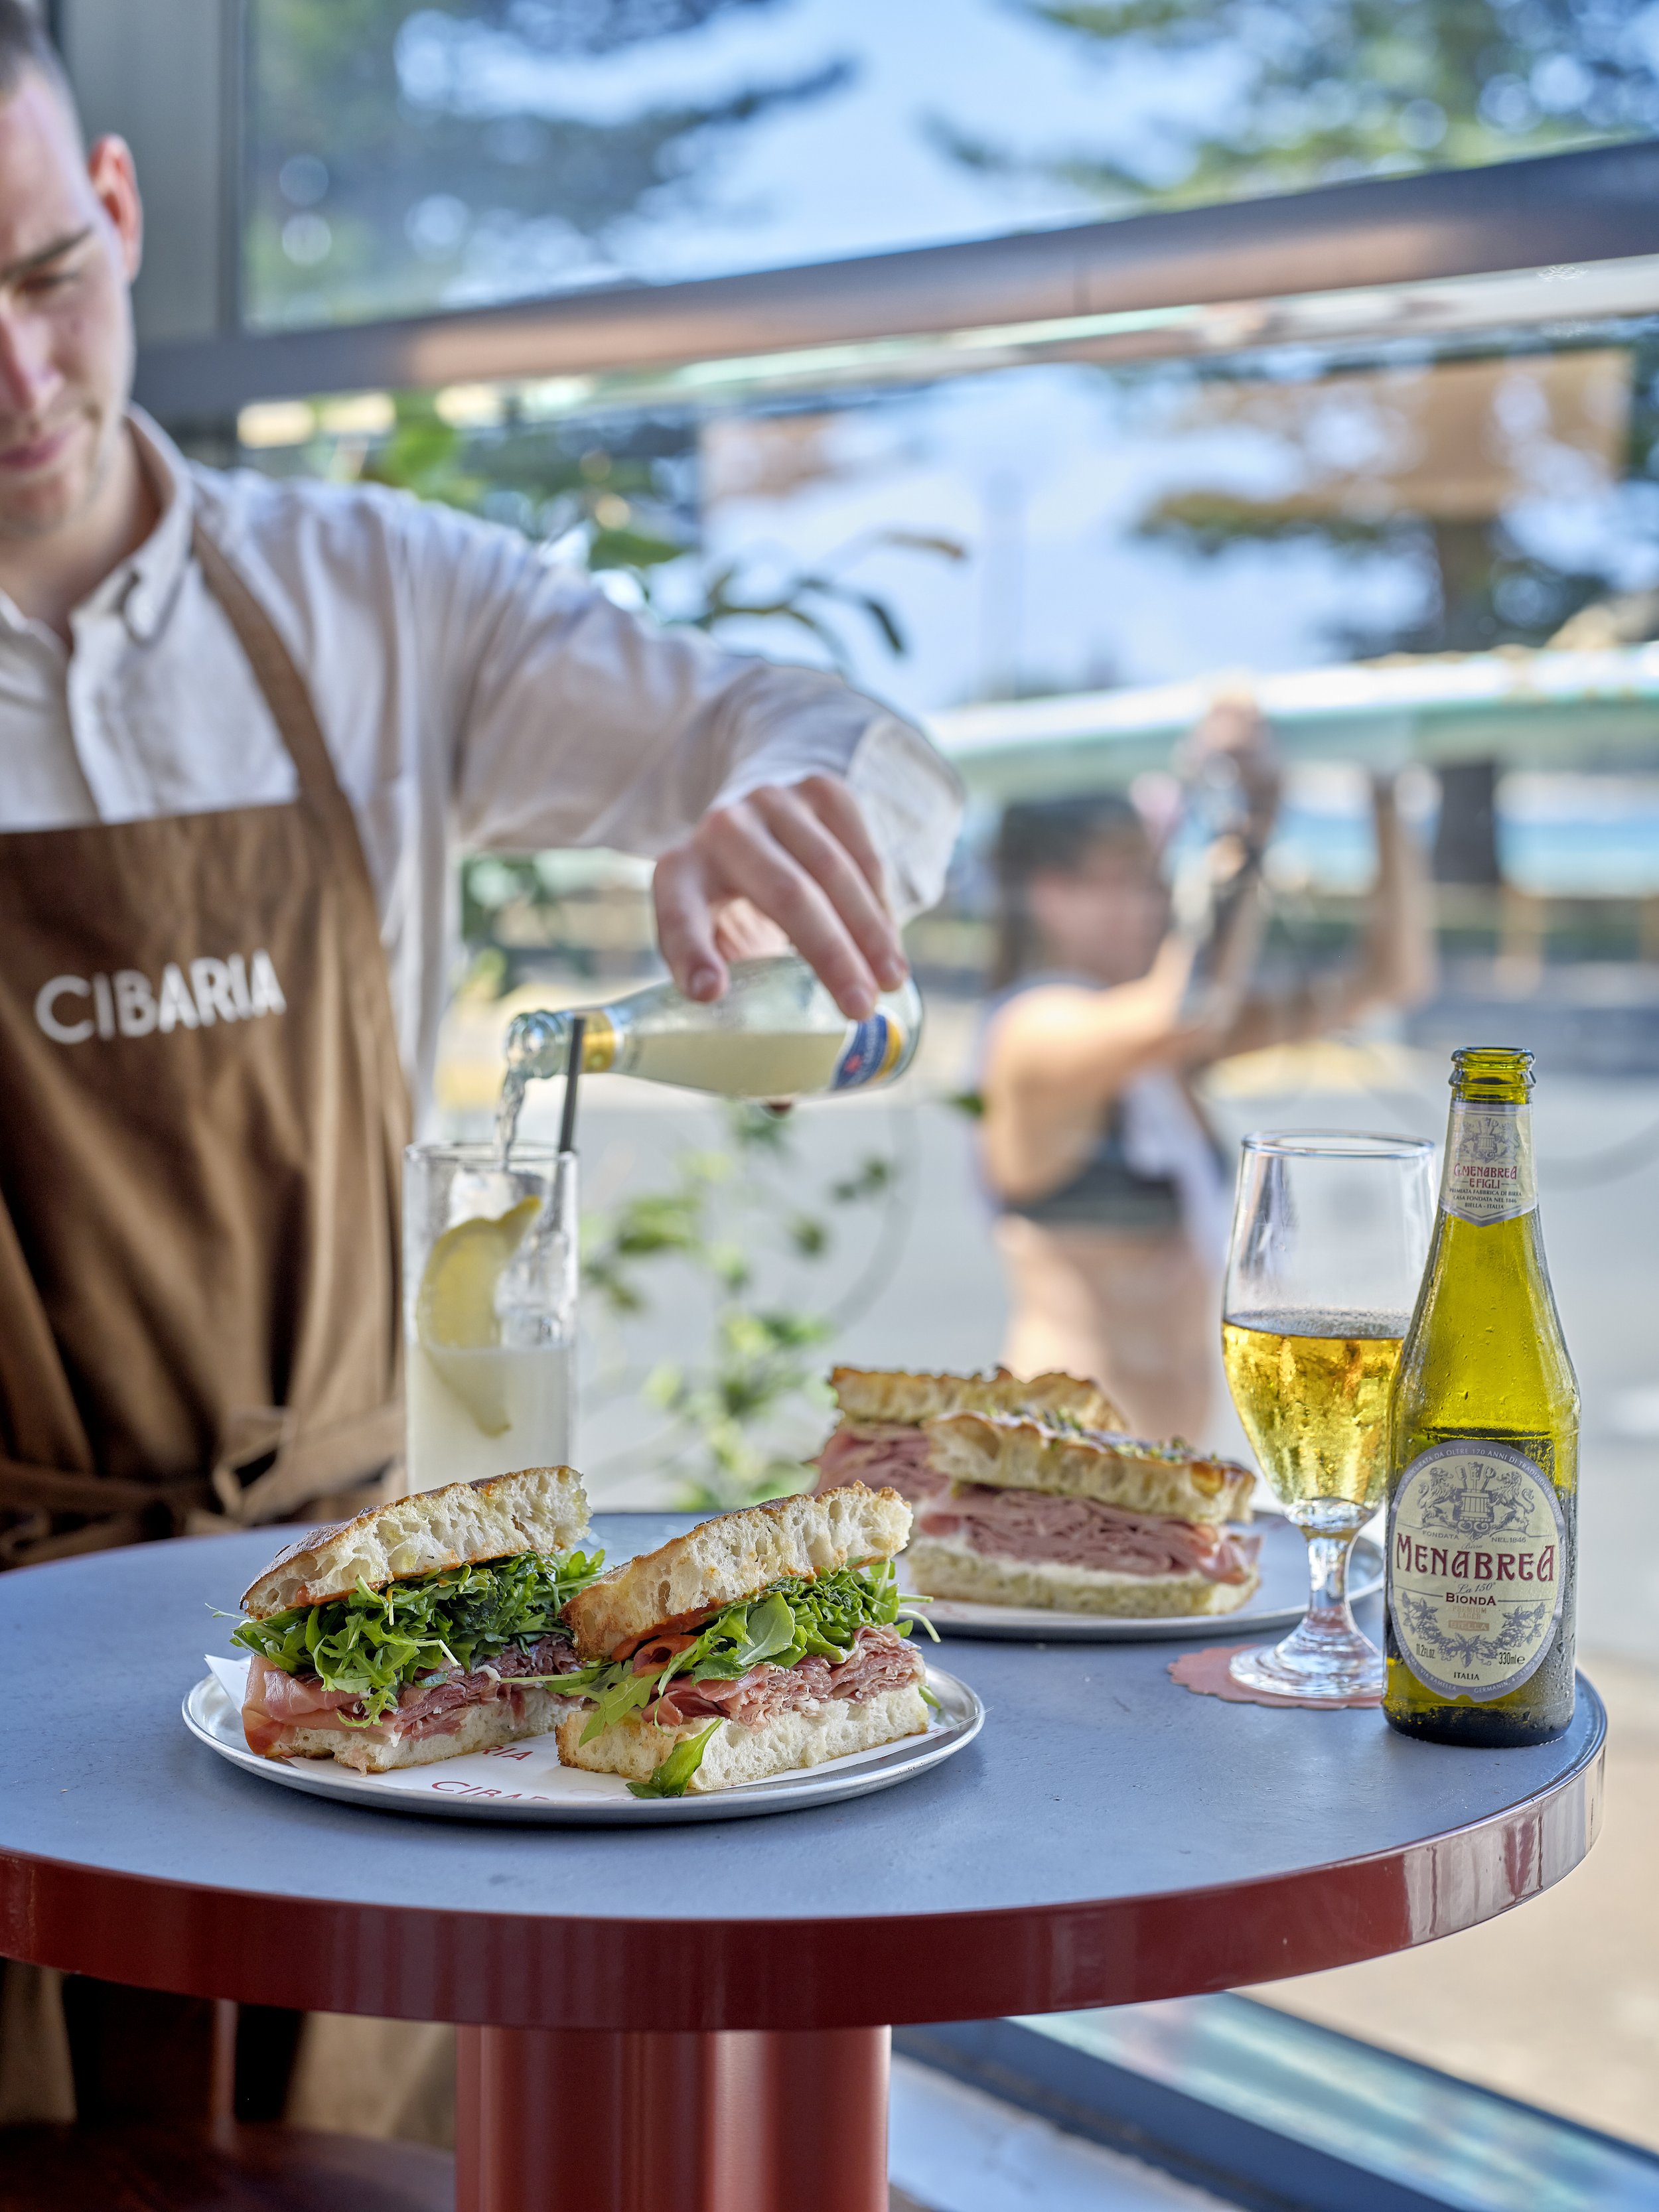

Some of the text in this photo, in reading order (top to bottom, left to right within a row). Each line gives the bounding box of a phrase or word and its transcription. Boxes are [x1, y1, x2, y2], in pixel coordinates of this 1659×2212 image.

[35, 947, 287, 1045] CIBARIA
[1470, 1178, 1500, 1189] E FIGLI
[1487, 1450, 1508, 1460] ANNI
[1519, 1461, 1550, 1493] TRADIZIONE
[1422, 1530, 1459, 1540] FONDATA
[1396, 1533, 1555, 1582] MENABREA
[1456, 1583, 1473, 1594] La
[1451, 1622, 1487, 1630] BIELLA
[1420, 1668, 1429, 1679] VIA
[1429, 1676, 1456, 1691] RAMELLA
[1454, 1672, 1480, 1681] ITALIA
